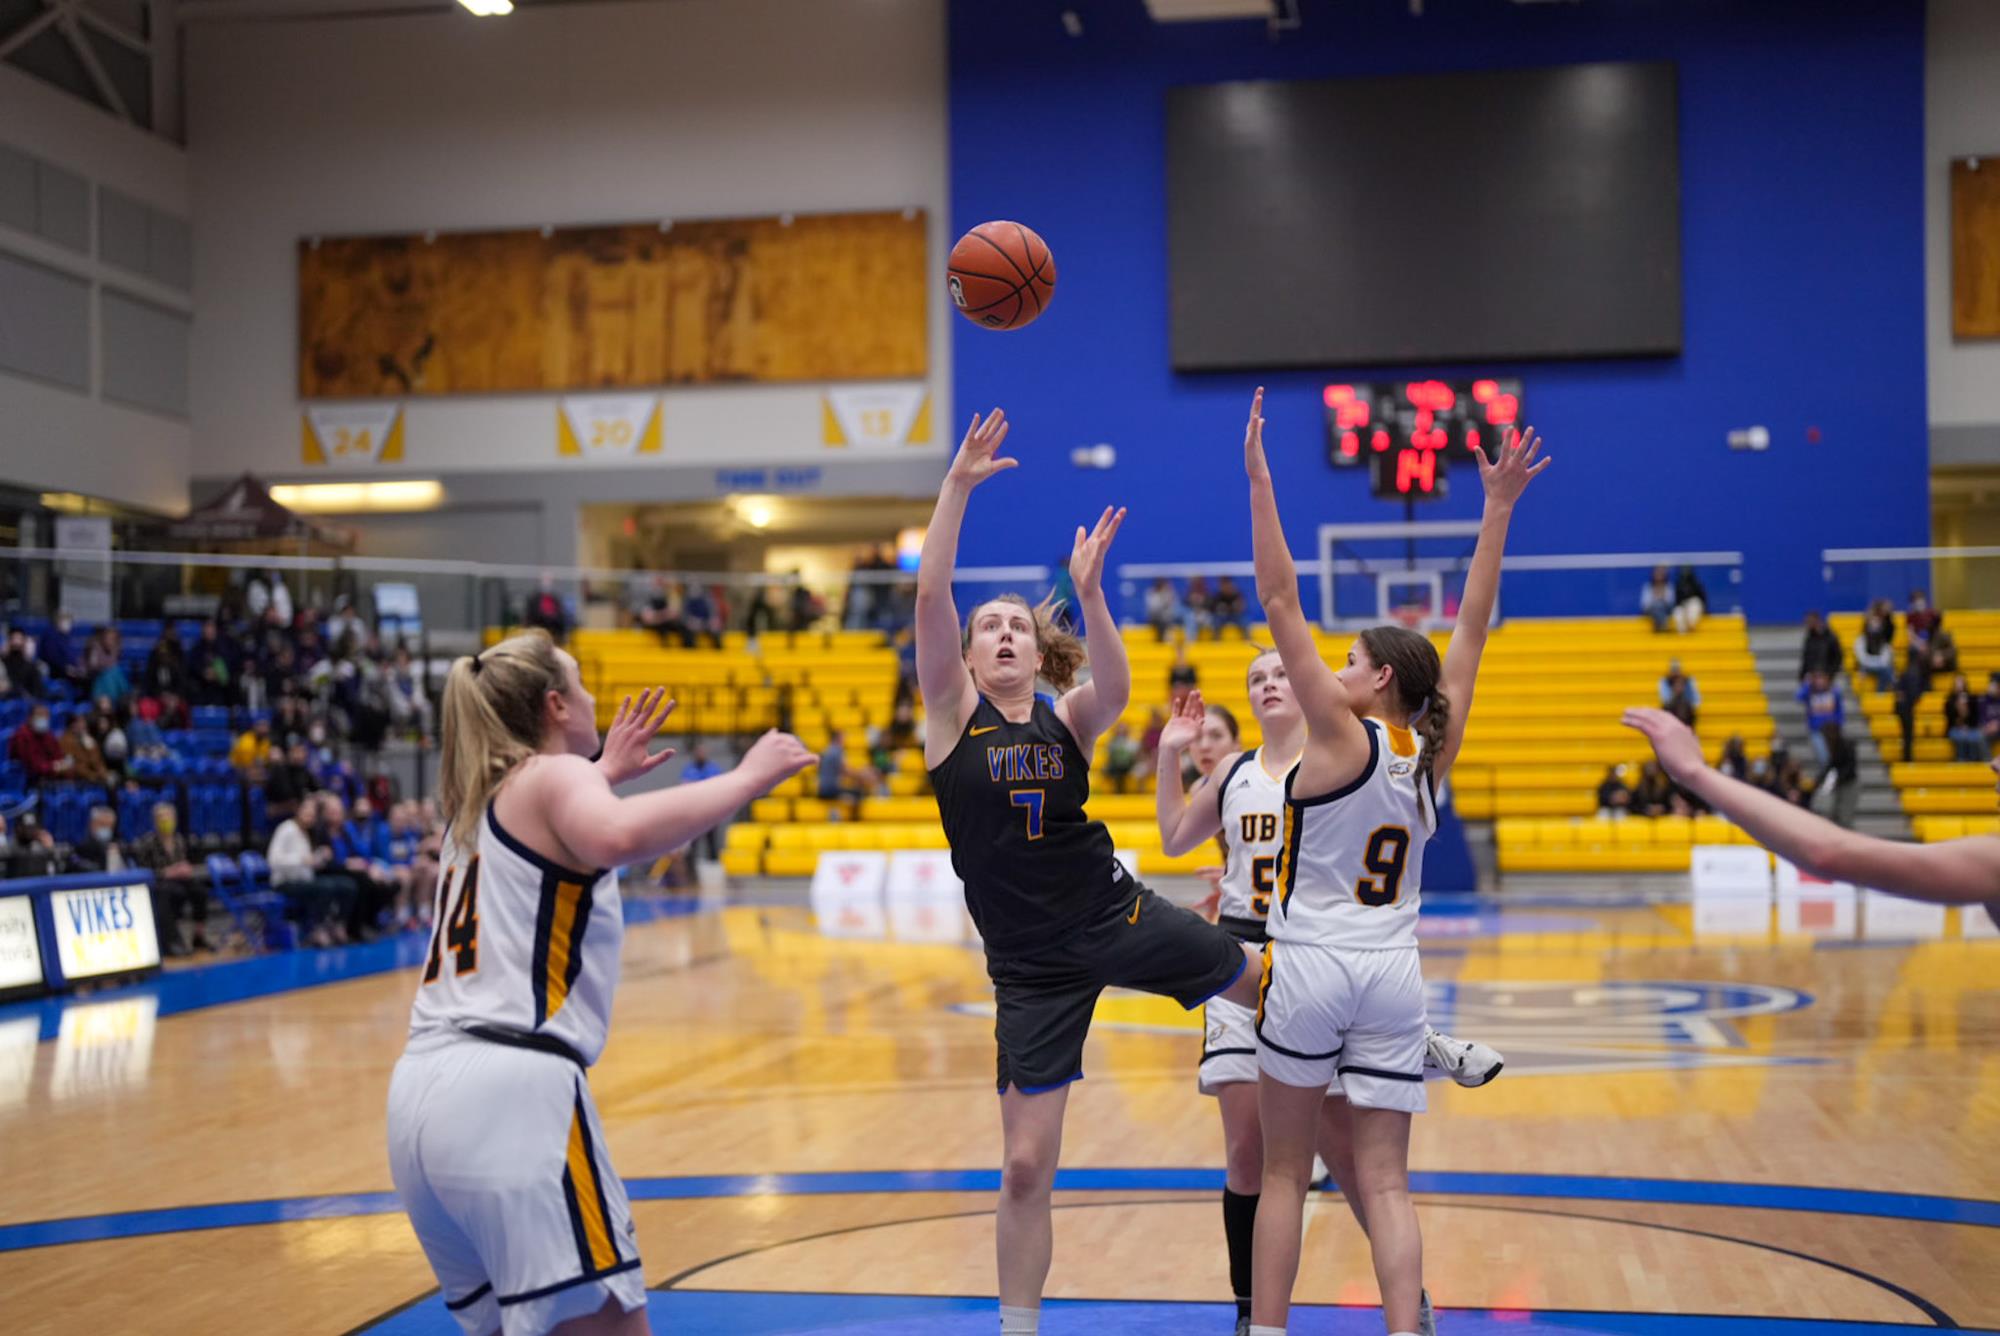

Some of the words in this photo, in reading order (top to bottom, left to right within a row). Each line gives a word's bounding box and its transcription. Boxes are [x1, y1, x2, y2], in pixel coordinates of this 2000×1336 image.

[987, 743, 1064, 782] VIKES
[1009, 788, 1045, 841] 7
[1240, 813, 1279, 843] UB
[1354, 824, 1411, 907] 9
[66, 887, 135, 935] VIKES
[423, 853, 482, 985] 14
